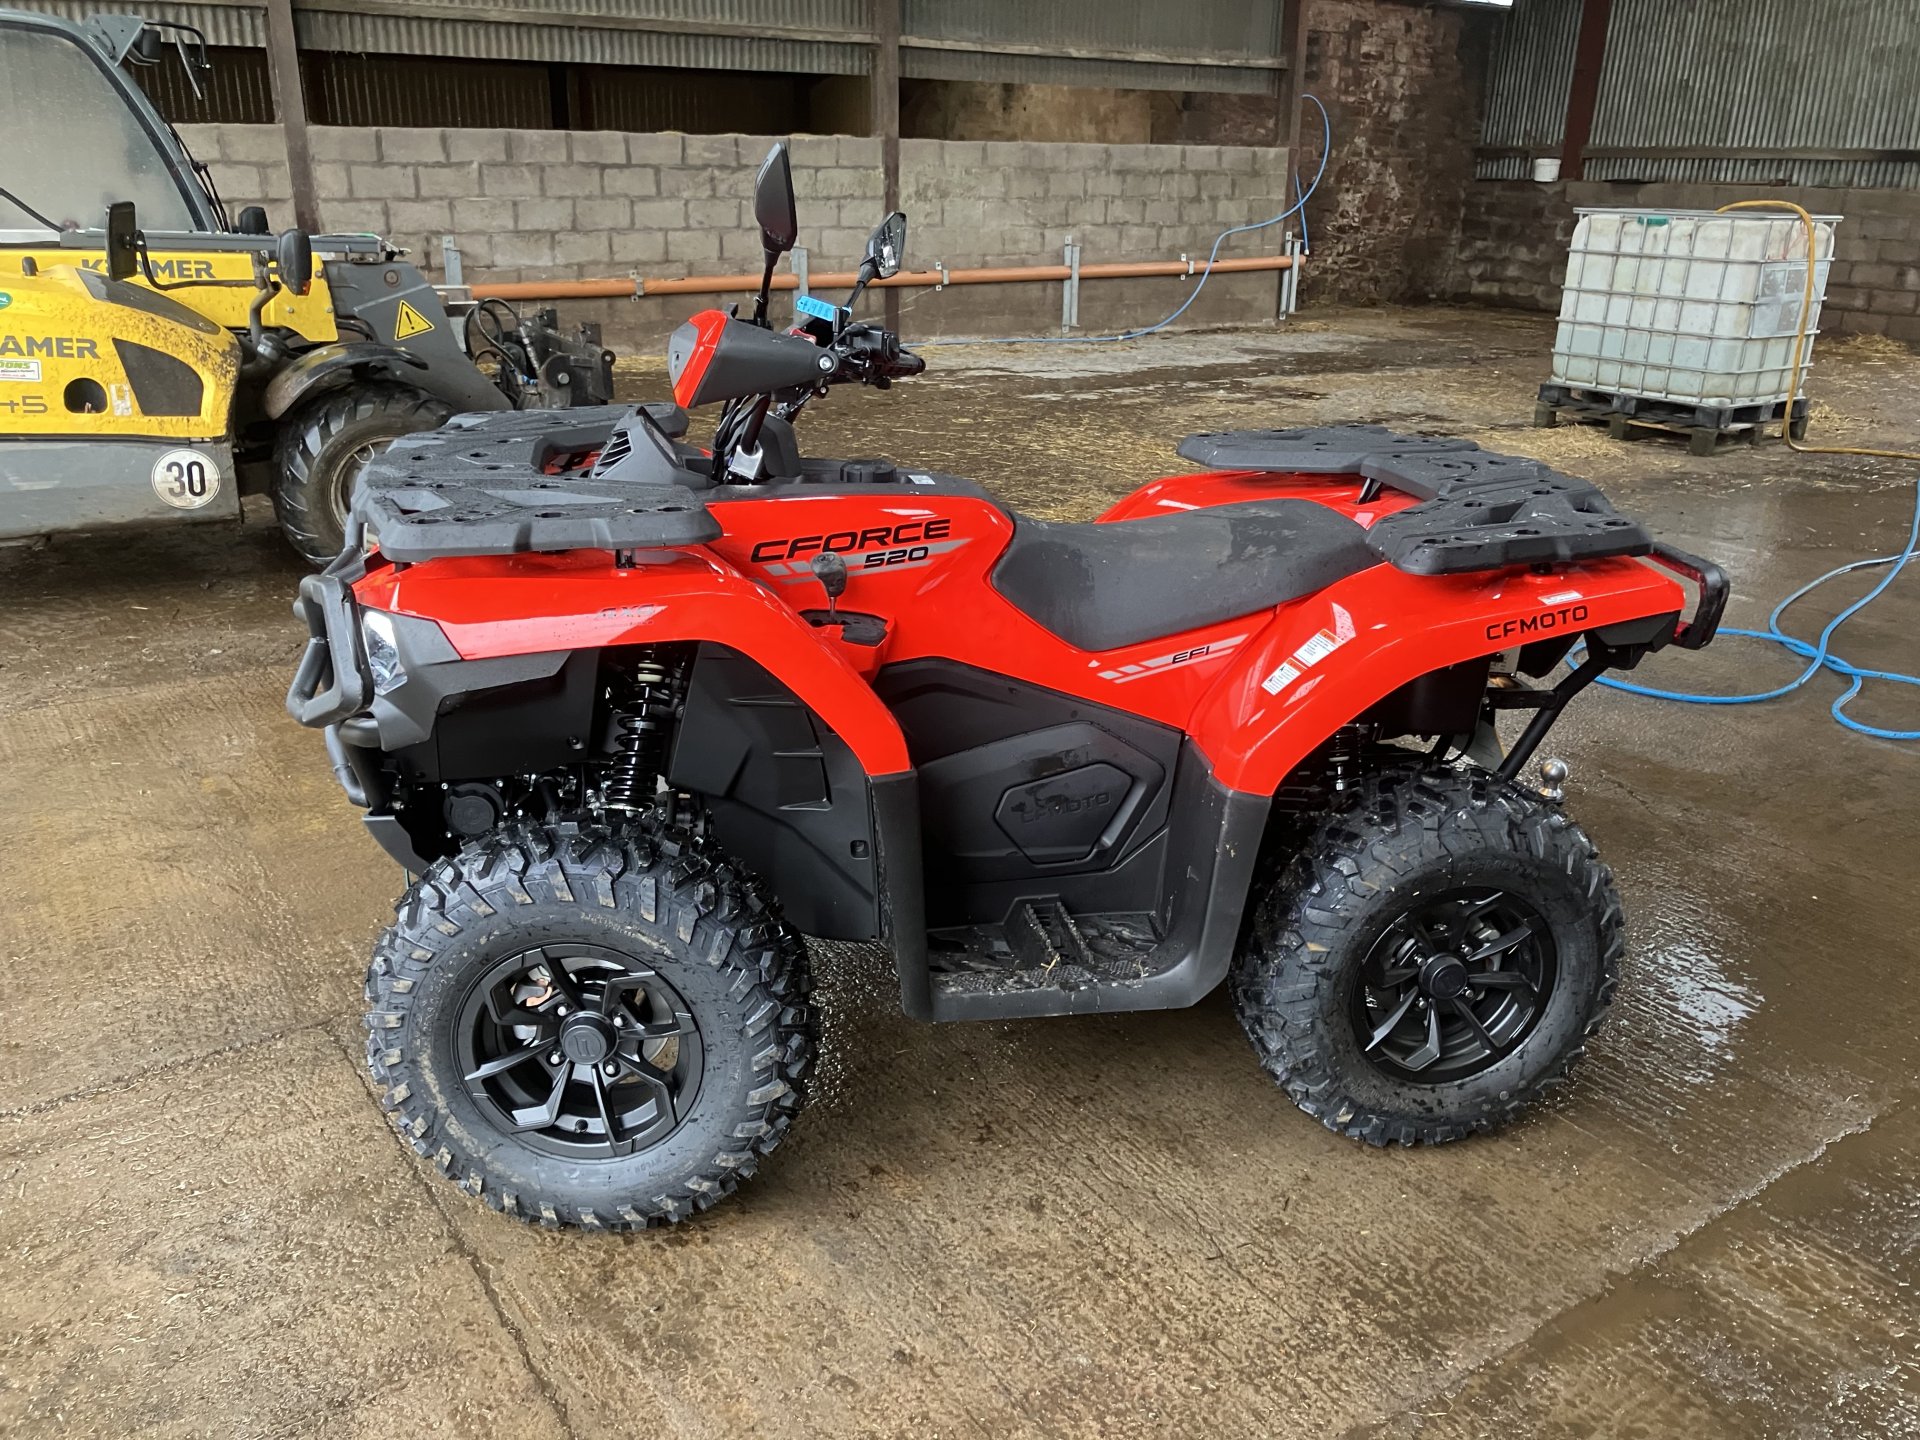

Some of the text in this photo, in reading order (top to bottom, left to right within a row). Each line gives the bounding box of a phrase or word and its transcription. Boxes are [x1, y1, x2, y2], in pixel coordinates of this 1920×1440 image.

[81, 258, 216, 279] KMER
[166, 460, 207, 498] 30
[750, 518, 952, 563] CFORCE
[863, 546, 929, 569] 520
[1486, 605, 1589, 641] CFMOTO
[1171, 645, 1211, 665] EFI
